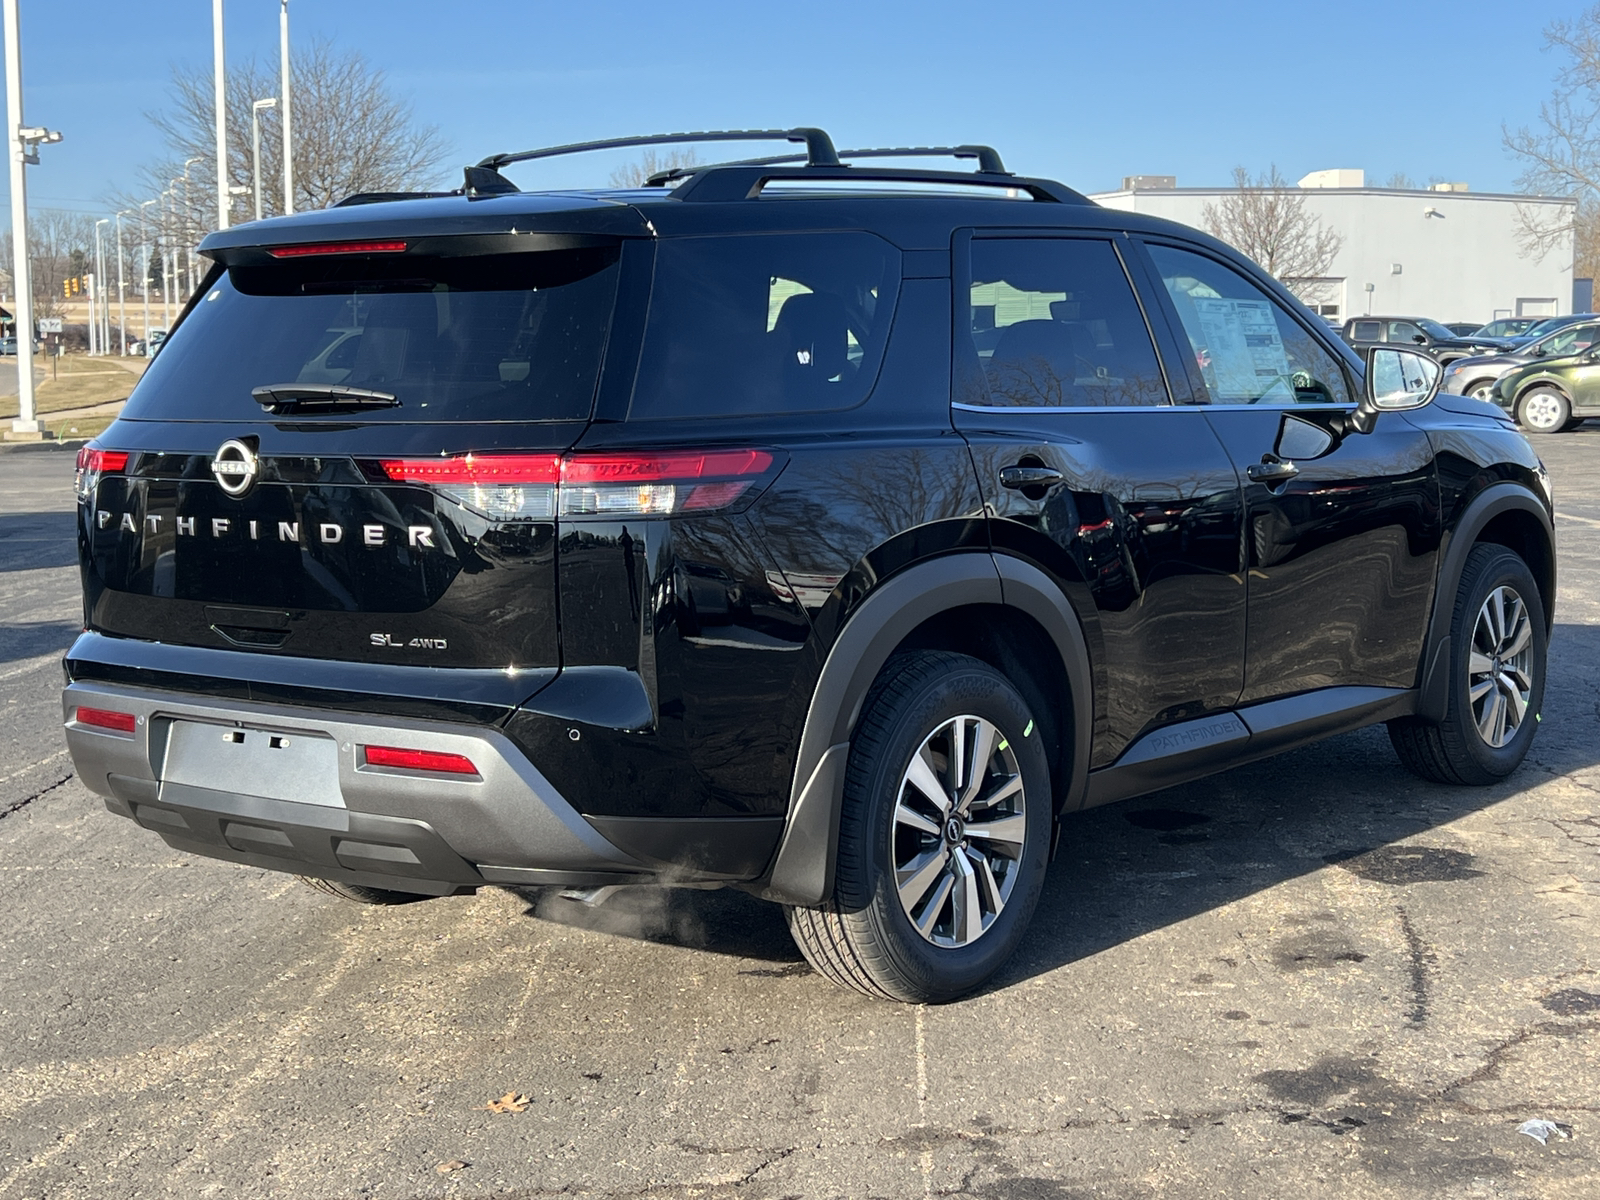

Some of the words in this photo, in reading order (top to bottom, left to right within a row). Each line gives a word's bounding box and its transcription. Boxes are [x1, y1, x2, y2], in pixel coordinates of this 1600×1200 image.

[211, 461, 256, 474] NISSAN
[97, 510, 435, 547] PATHFINDER
[370, 633, 404, 646] SL
[408, 638, 448, 649] 4WD
[1151, 719, 1243, 752] PATHFINDER
